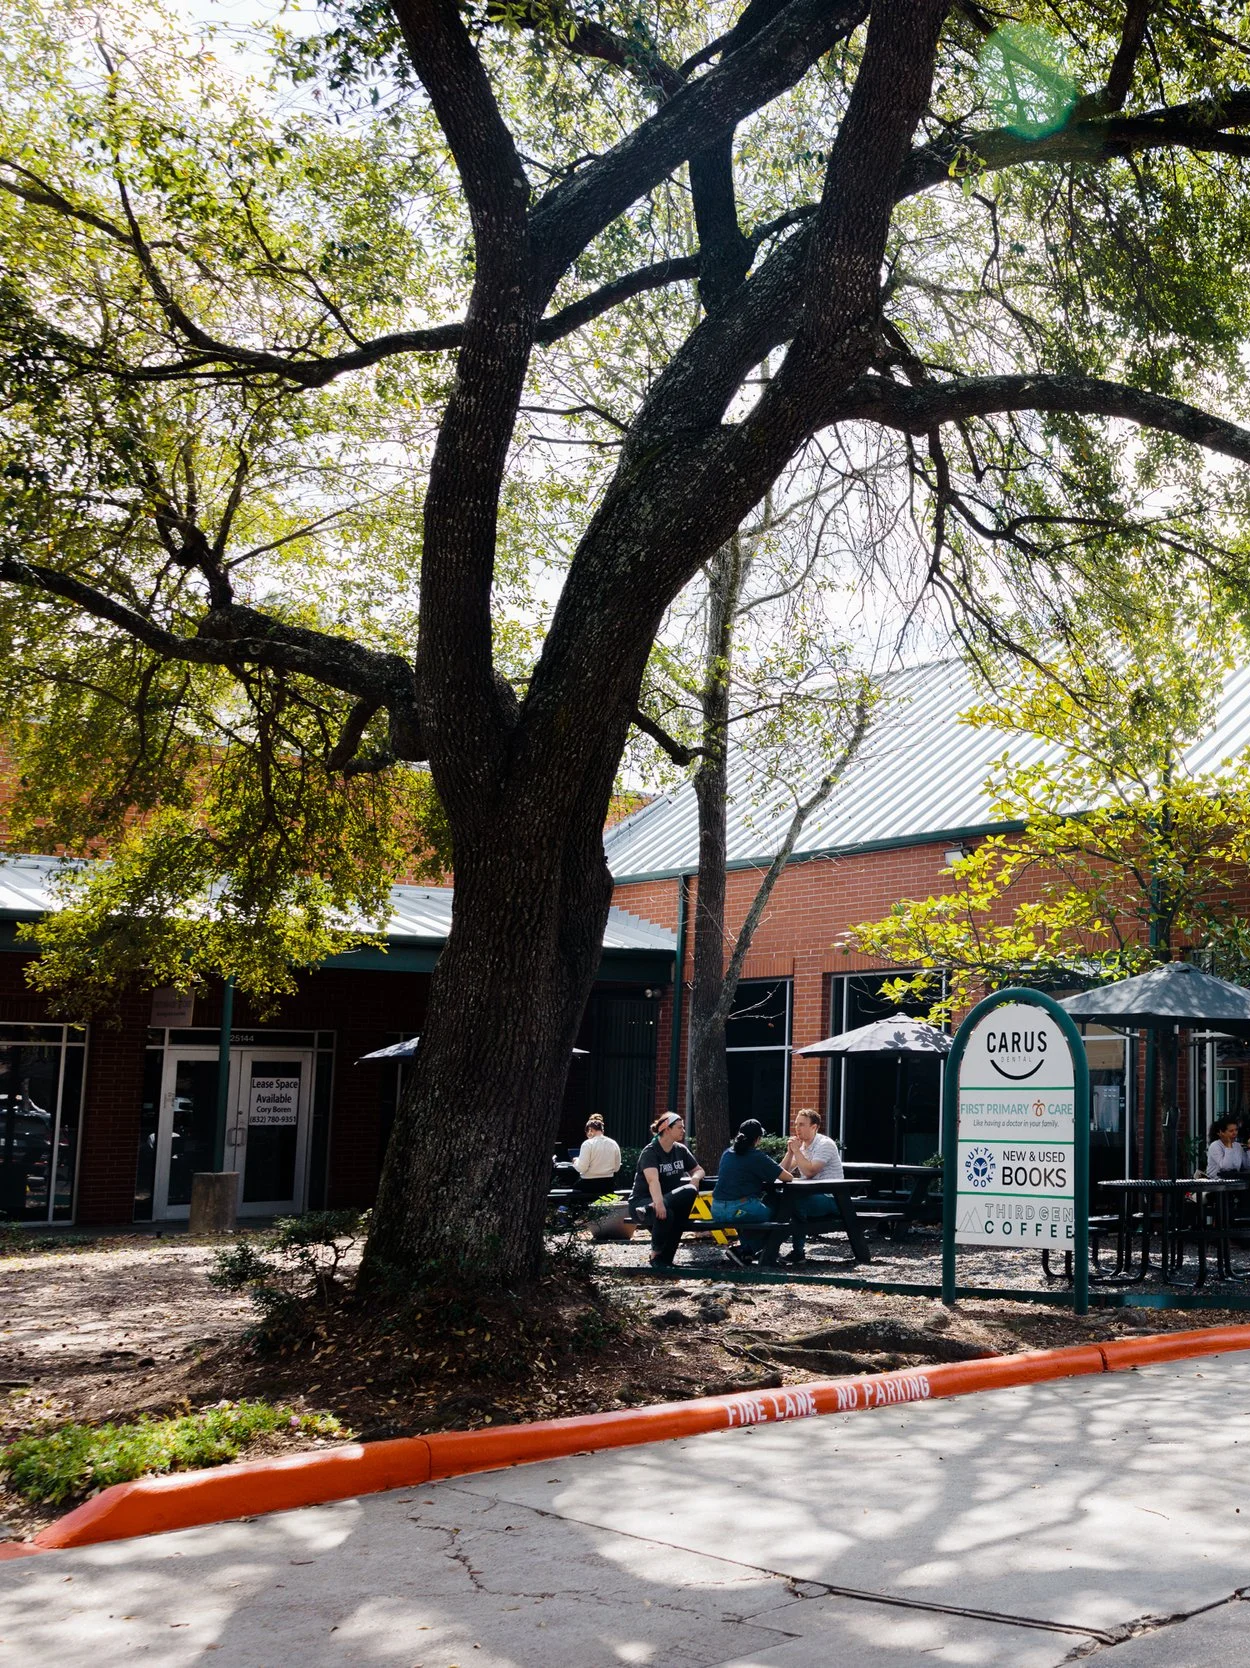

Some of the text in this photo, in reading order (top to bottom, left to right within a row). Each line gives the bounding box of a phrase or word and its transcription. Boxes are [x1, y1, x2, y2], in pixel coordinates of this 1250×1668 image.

[230, 1034, 254, 1042] 25144
[987, 1031, 1048, 1053] CARUS
[252, 1079, 298, 1090] Lease Space
[256, 1094, 292, 1104] Available
[256, 1105, 292, 1114] Cory Boren
[960, 1104, 1073, 1115] FIRST PRIMARY CARE
[250, 1115, 266, 1124] (832)
[984, 1120, 1001, 1128] having
[965, 1147, 996, 1169] BUY THE
[1002, 1150, 1066, 1162] NEW & USED
[966, 1174, 994, 1188] BOOK
[1002, 1166, 1067, 1188] BOOKS
[984, 1203, 1074, 1223] THIRD GEN
[984, 1220, 1073, 1239] COFFEE
[724, 1375, 931, 1426] FIRE LANE NO PARKING
